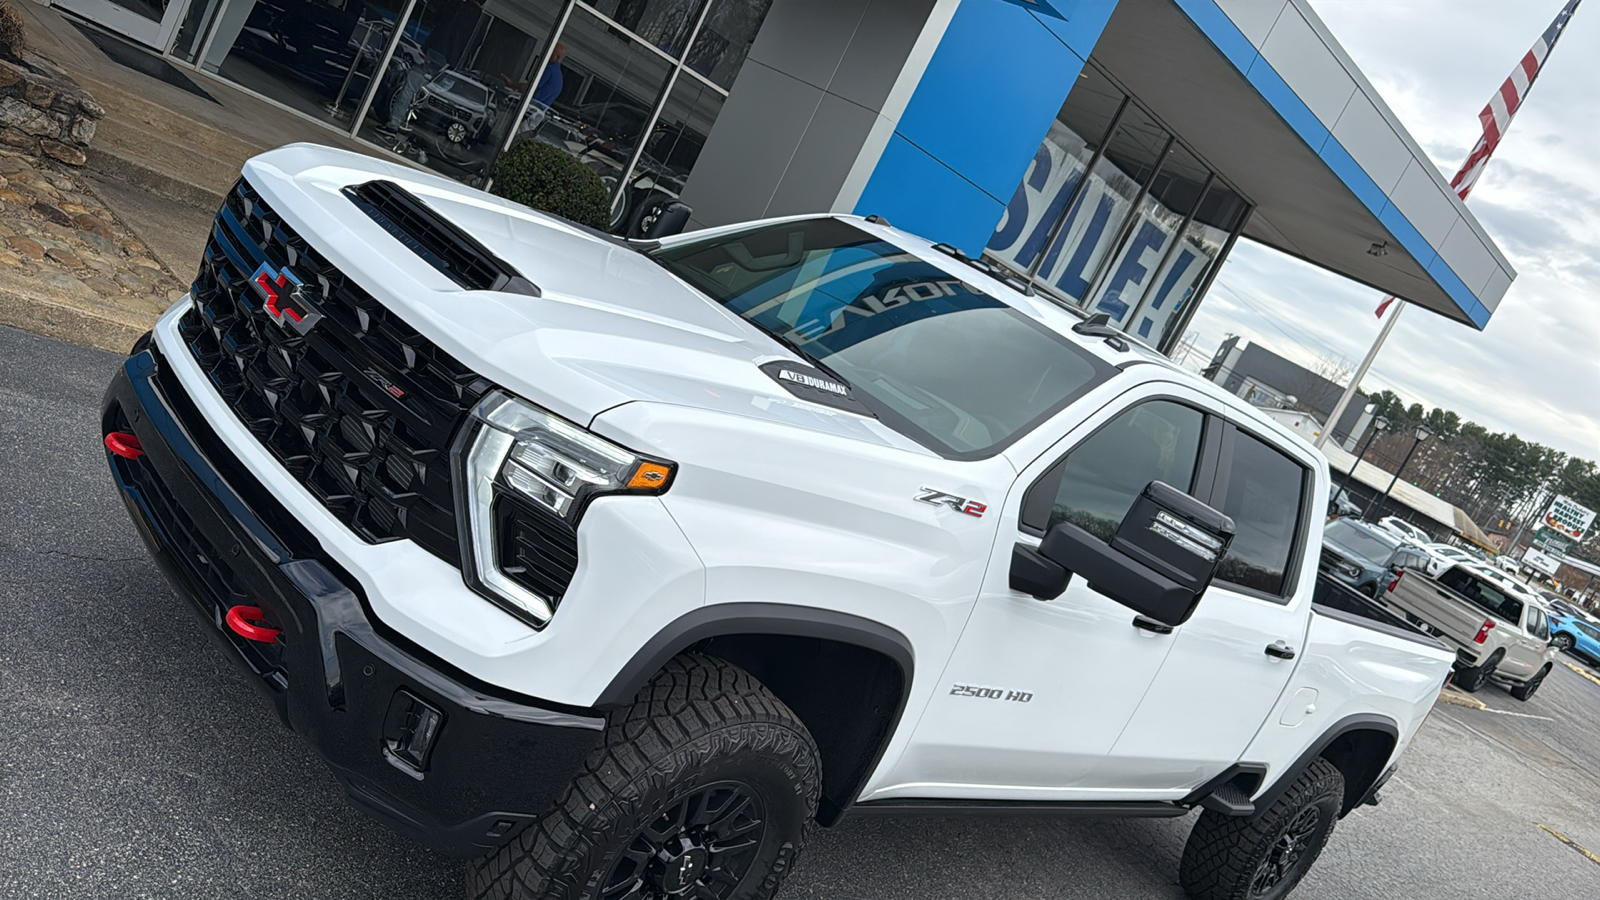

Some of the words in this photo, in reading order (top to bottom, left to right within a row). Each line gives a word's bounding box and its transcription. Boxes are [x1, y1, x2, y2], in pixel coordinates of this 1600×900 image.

[986, 143, 1196, 339] SALE!
[363, 366, 405, 399] ZR2
[786, 371, 806, 384] V8
[808, 377, 847, 395] DURAMAX
[913, 485, 987, 518] ZR2
[1553, 500, 1585, 519] HEALTHY
[1552, 513, 1586, 534] PRODUCE
[1554, 507, 1586, 527] HARVEST
[949, 684, 1004, 700] 2500
[1004, 689, 1034, 704] HD
